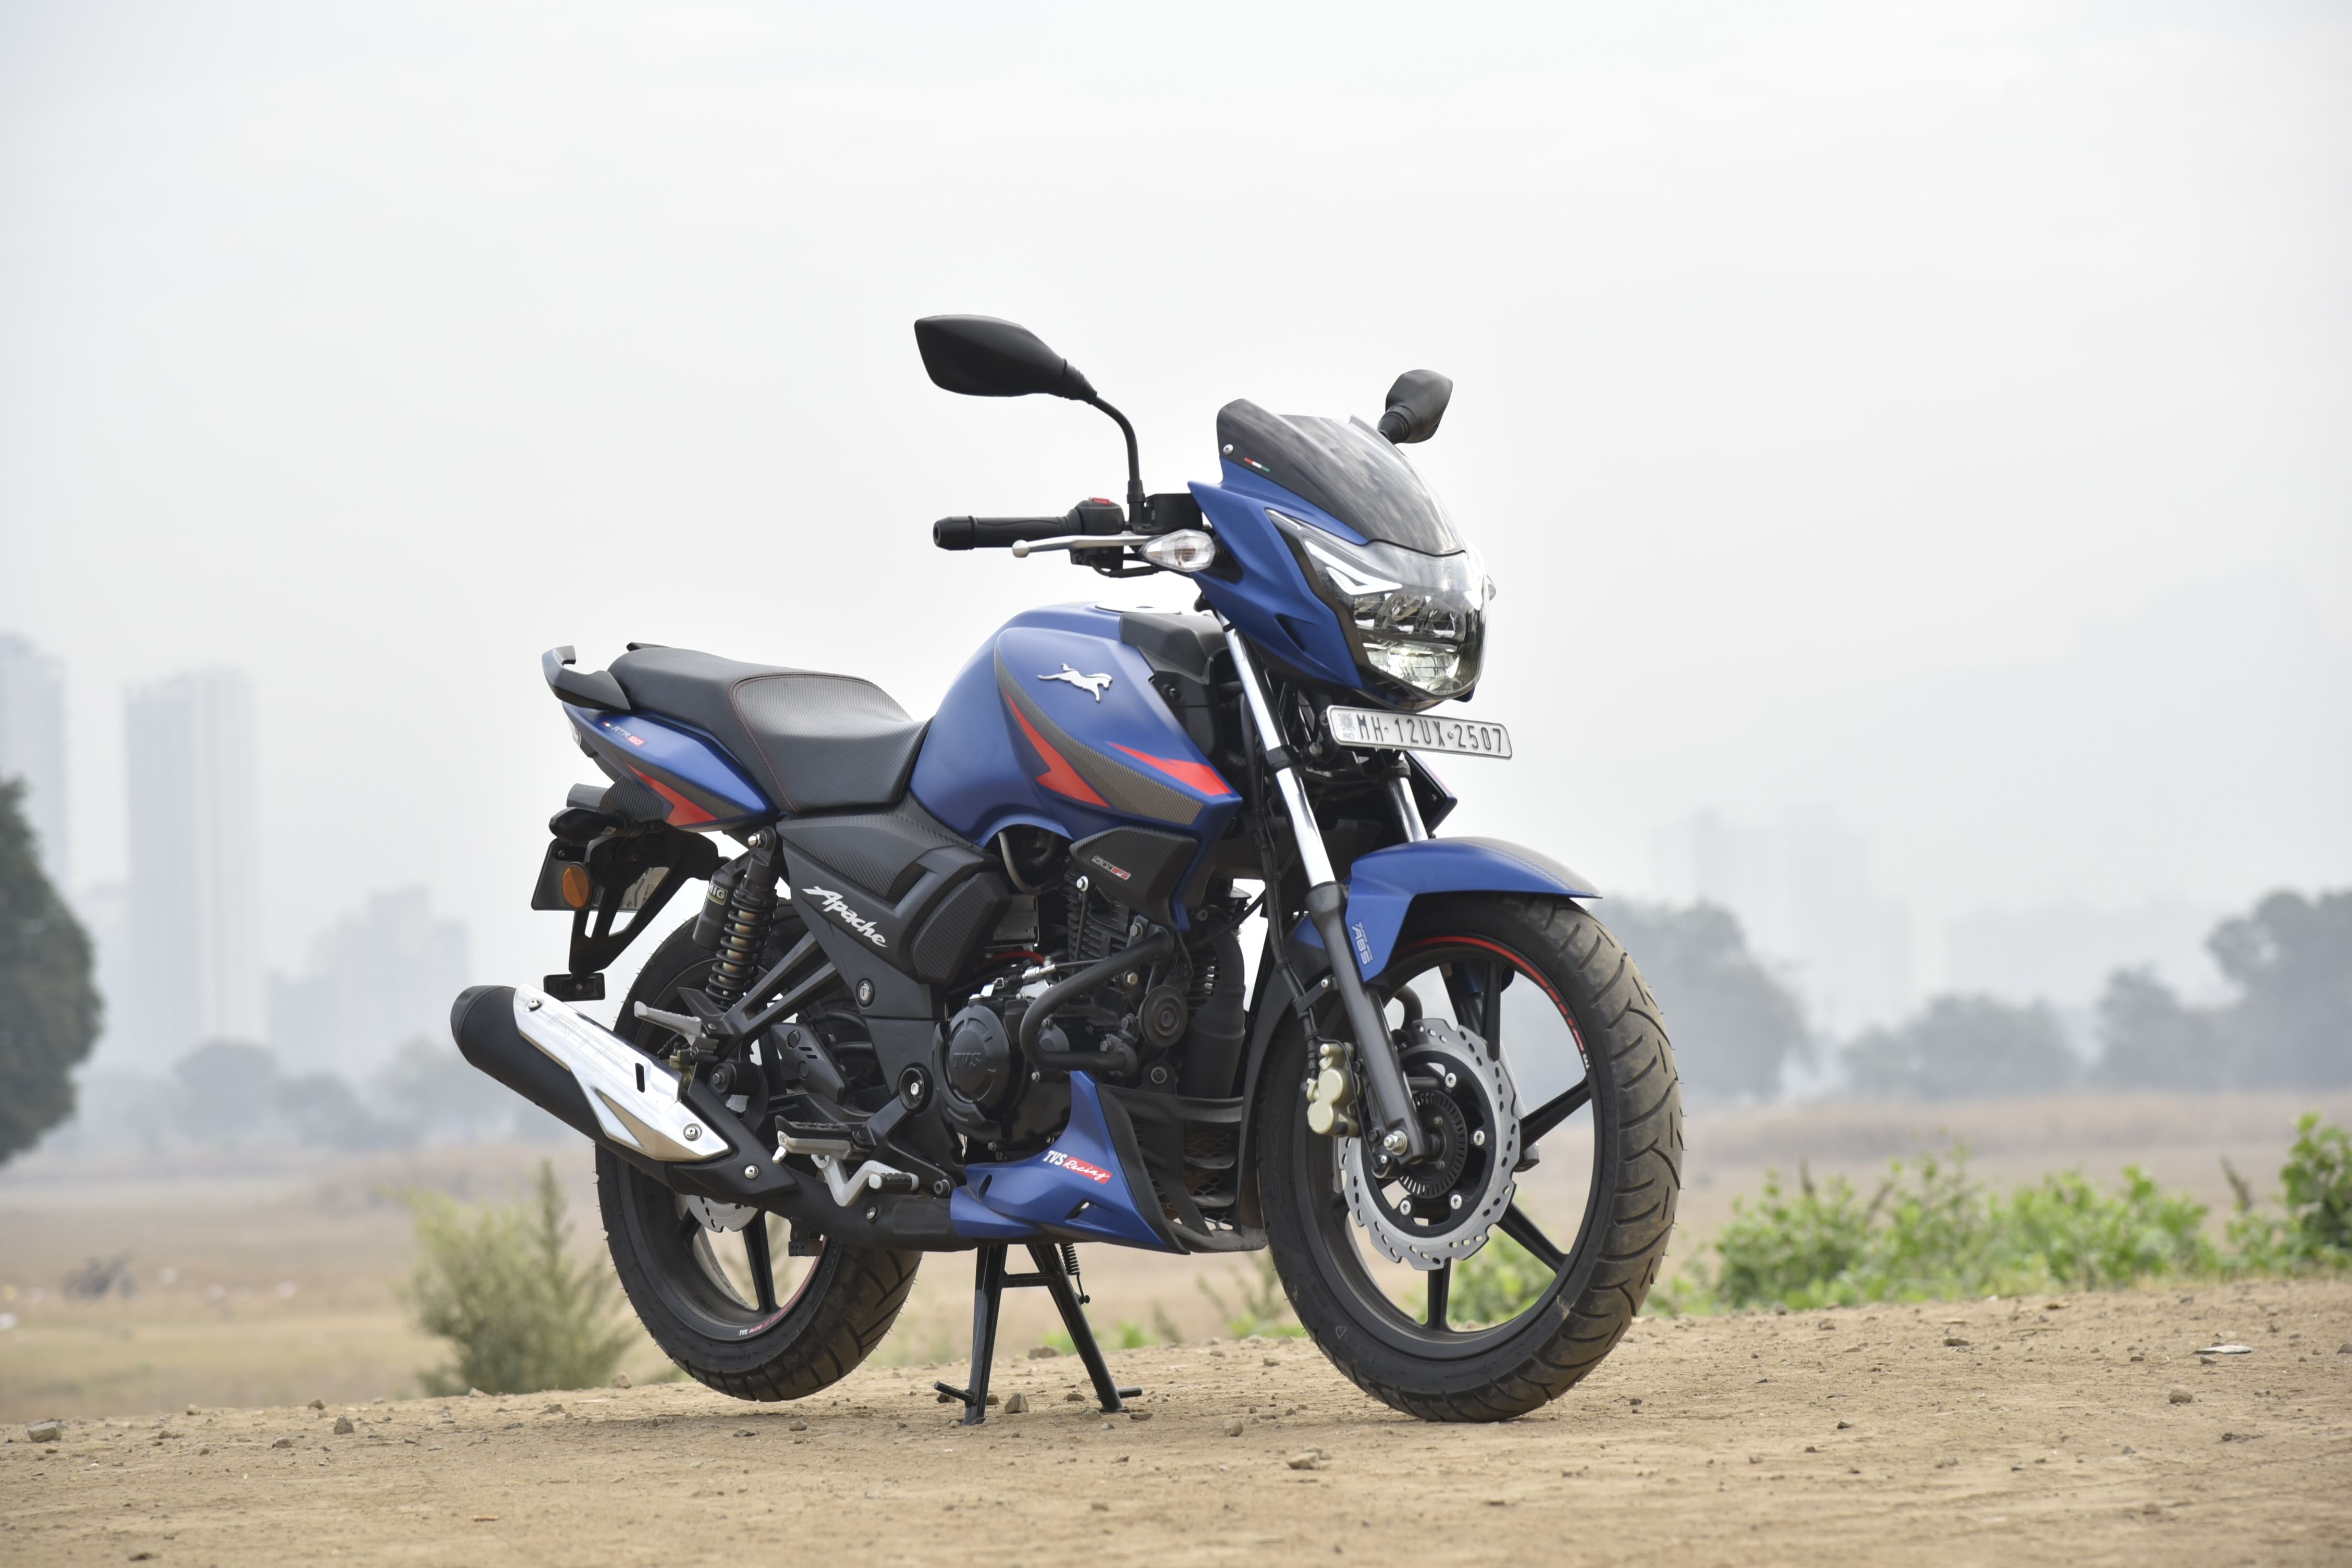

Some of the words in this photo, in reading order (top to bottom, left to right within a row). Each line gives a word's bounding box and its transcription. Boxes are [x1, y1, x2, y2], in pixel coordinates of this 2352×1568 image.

[1356, 714, 1384, 742] MH
[1394, 718, 1446, 747] 12UX
[1454, 724, 1502, 752] 2507
[801, 886, 888, 948] Apache
[1351, 925, 1370, 965] ABS
[953, 1052, 982, 1069] TVS
[1043, 1150, 1068, 1166] TVS
[1062, 1159, 1110, 1181] Racing
